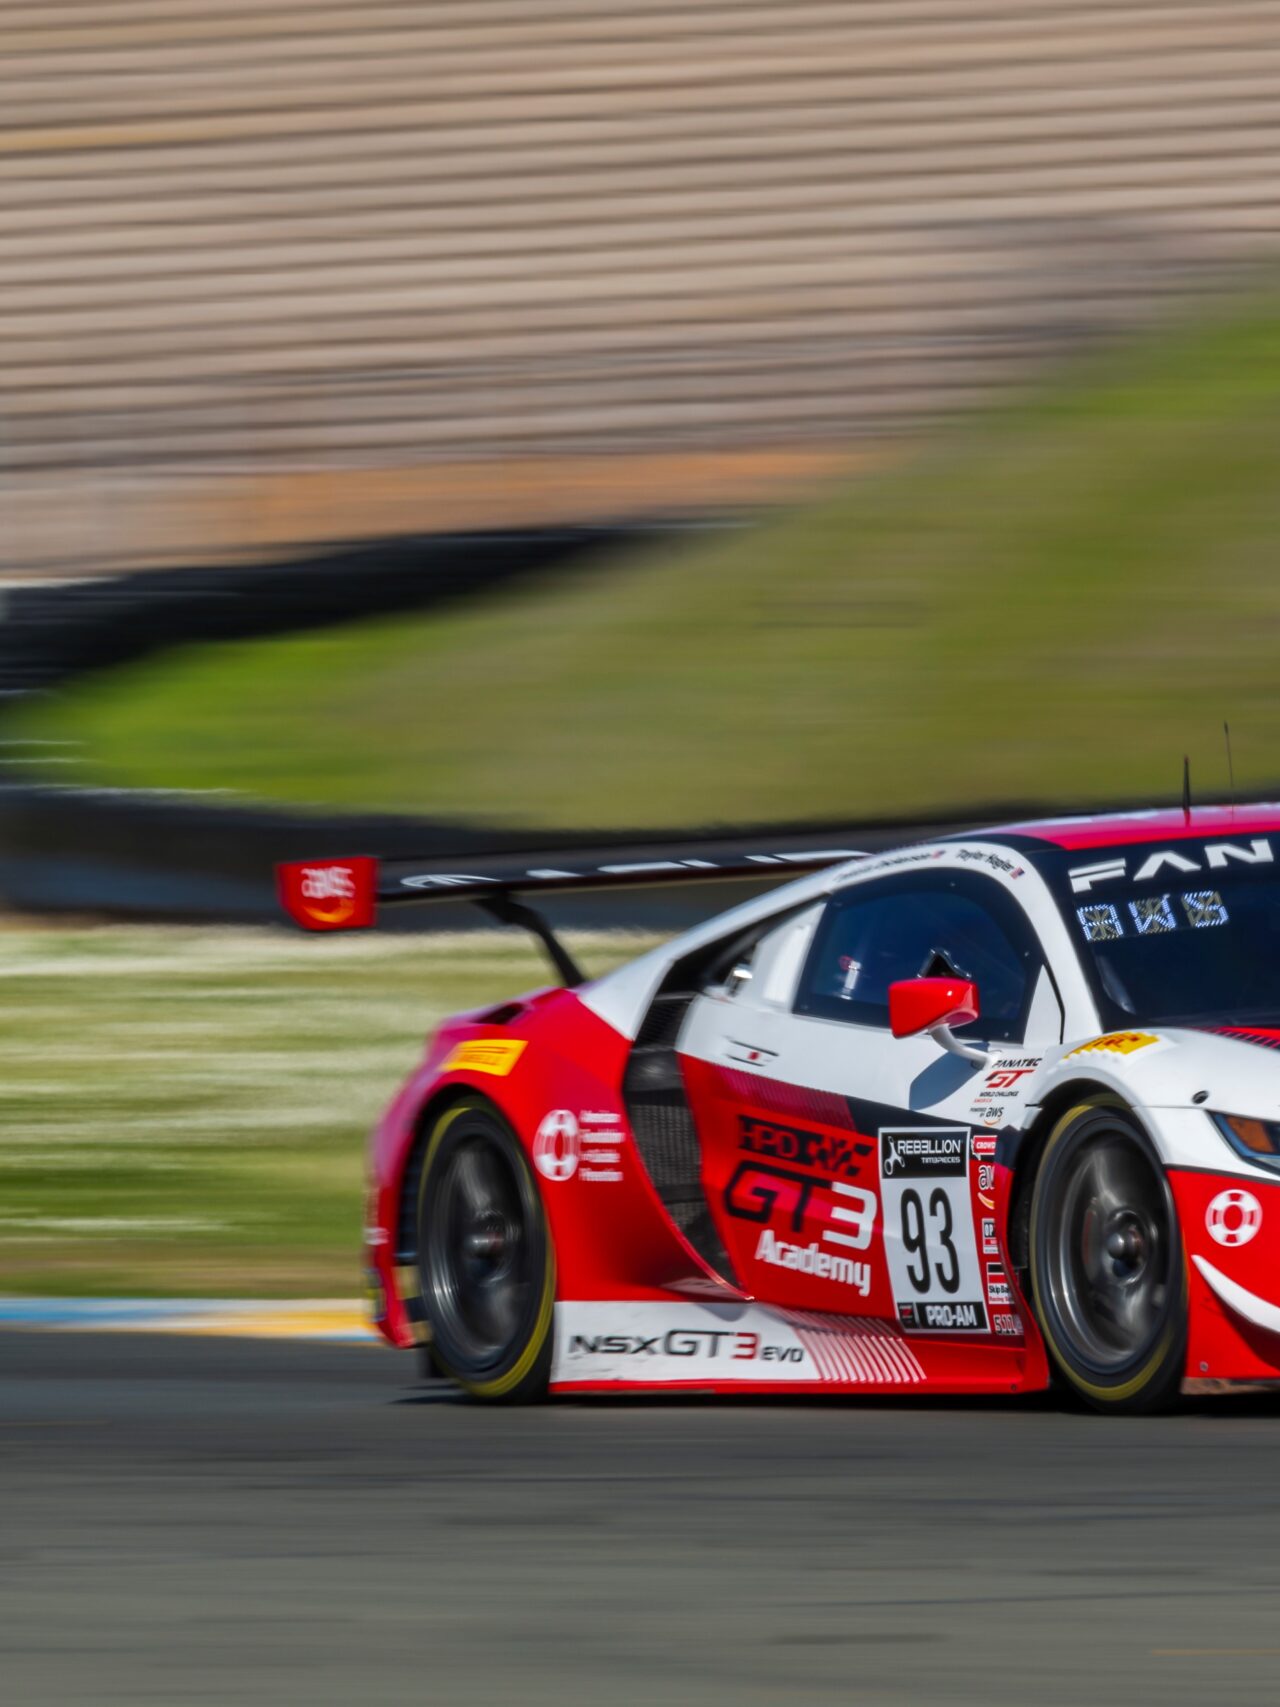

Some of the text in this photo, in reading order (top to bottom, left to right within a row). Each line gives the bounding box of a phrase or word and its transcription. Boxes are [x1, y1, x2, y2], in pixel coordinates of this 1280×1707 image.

[1076, 890, 1229, 942] AWS
[992, 1057, 1043, 1068] FANATEC
[984, 1069, 1035, 1088] GT
[986, 1107, 1004, 1117] aws
[897, 1139, 961, 1155] REBELLION
[724, 1159, 878, 1251] GT3
[900, 1186, 961, 1295] 93
[754, 1228, 872, 1297] Academy
[989, 1284, 1000, 1294] Skip
[925, 1304, 978, 1327] PRO-AM
[568, 1335, 661, 1355] NSX
[663, 1328, 761, 1360] GT3
